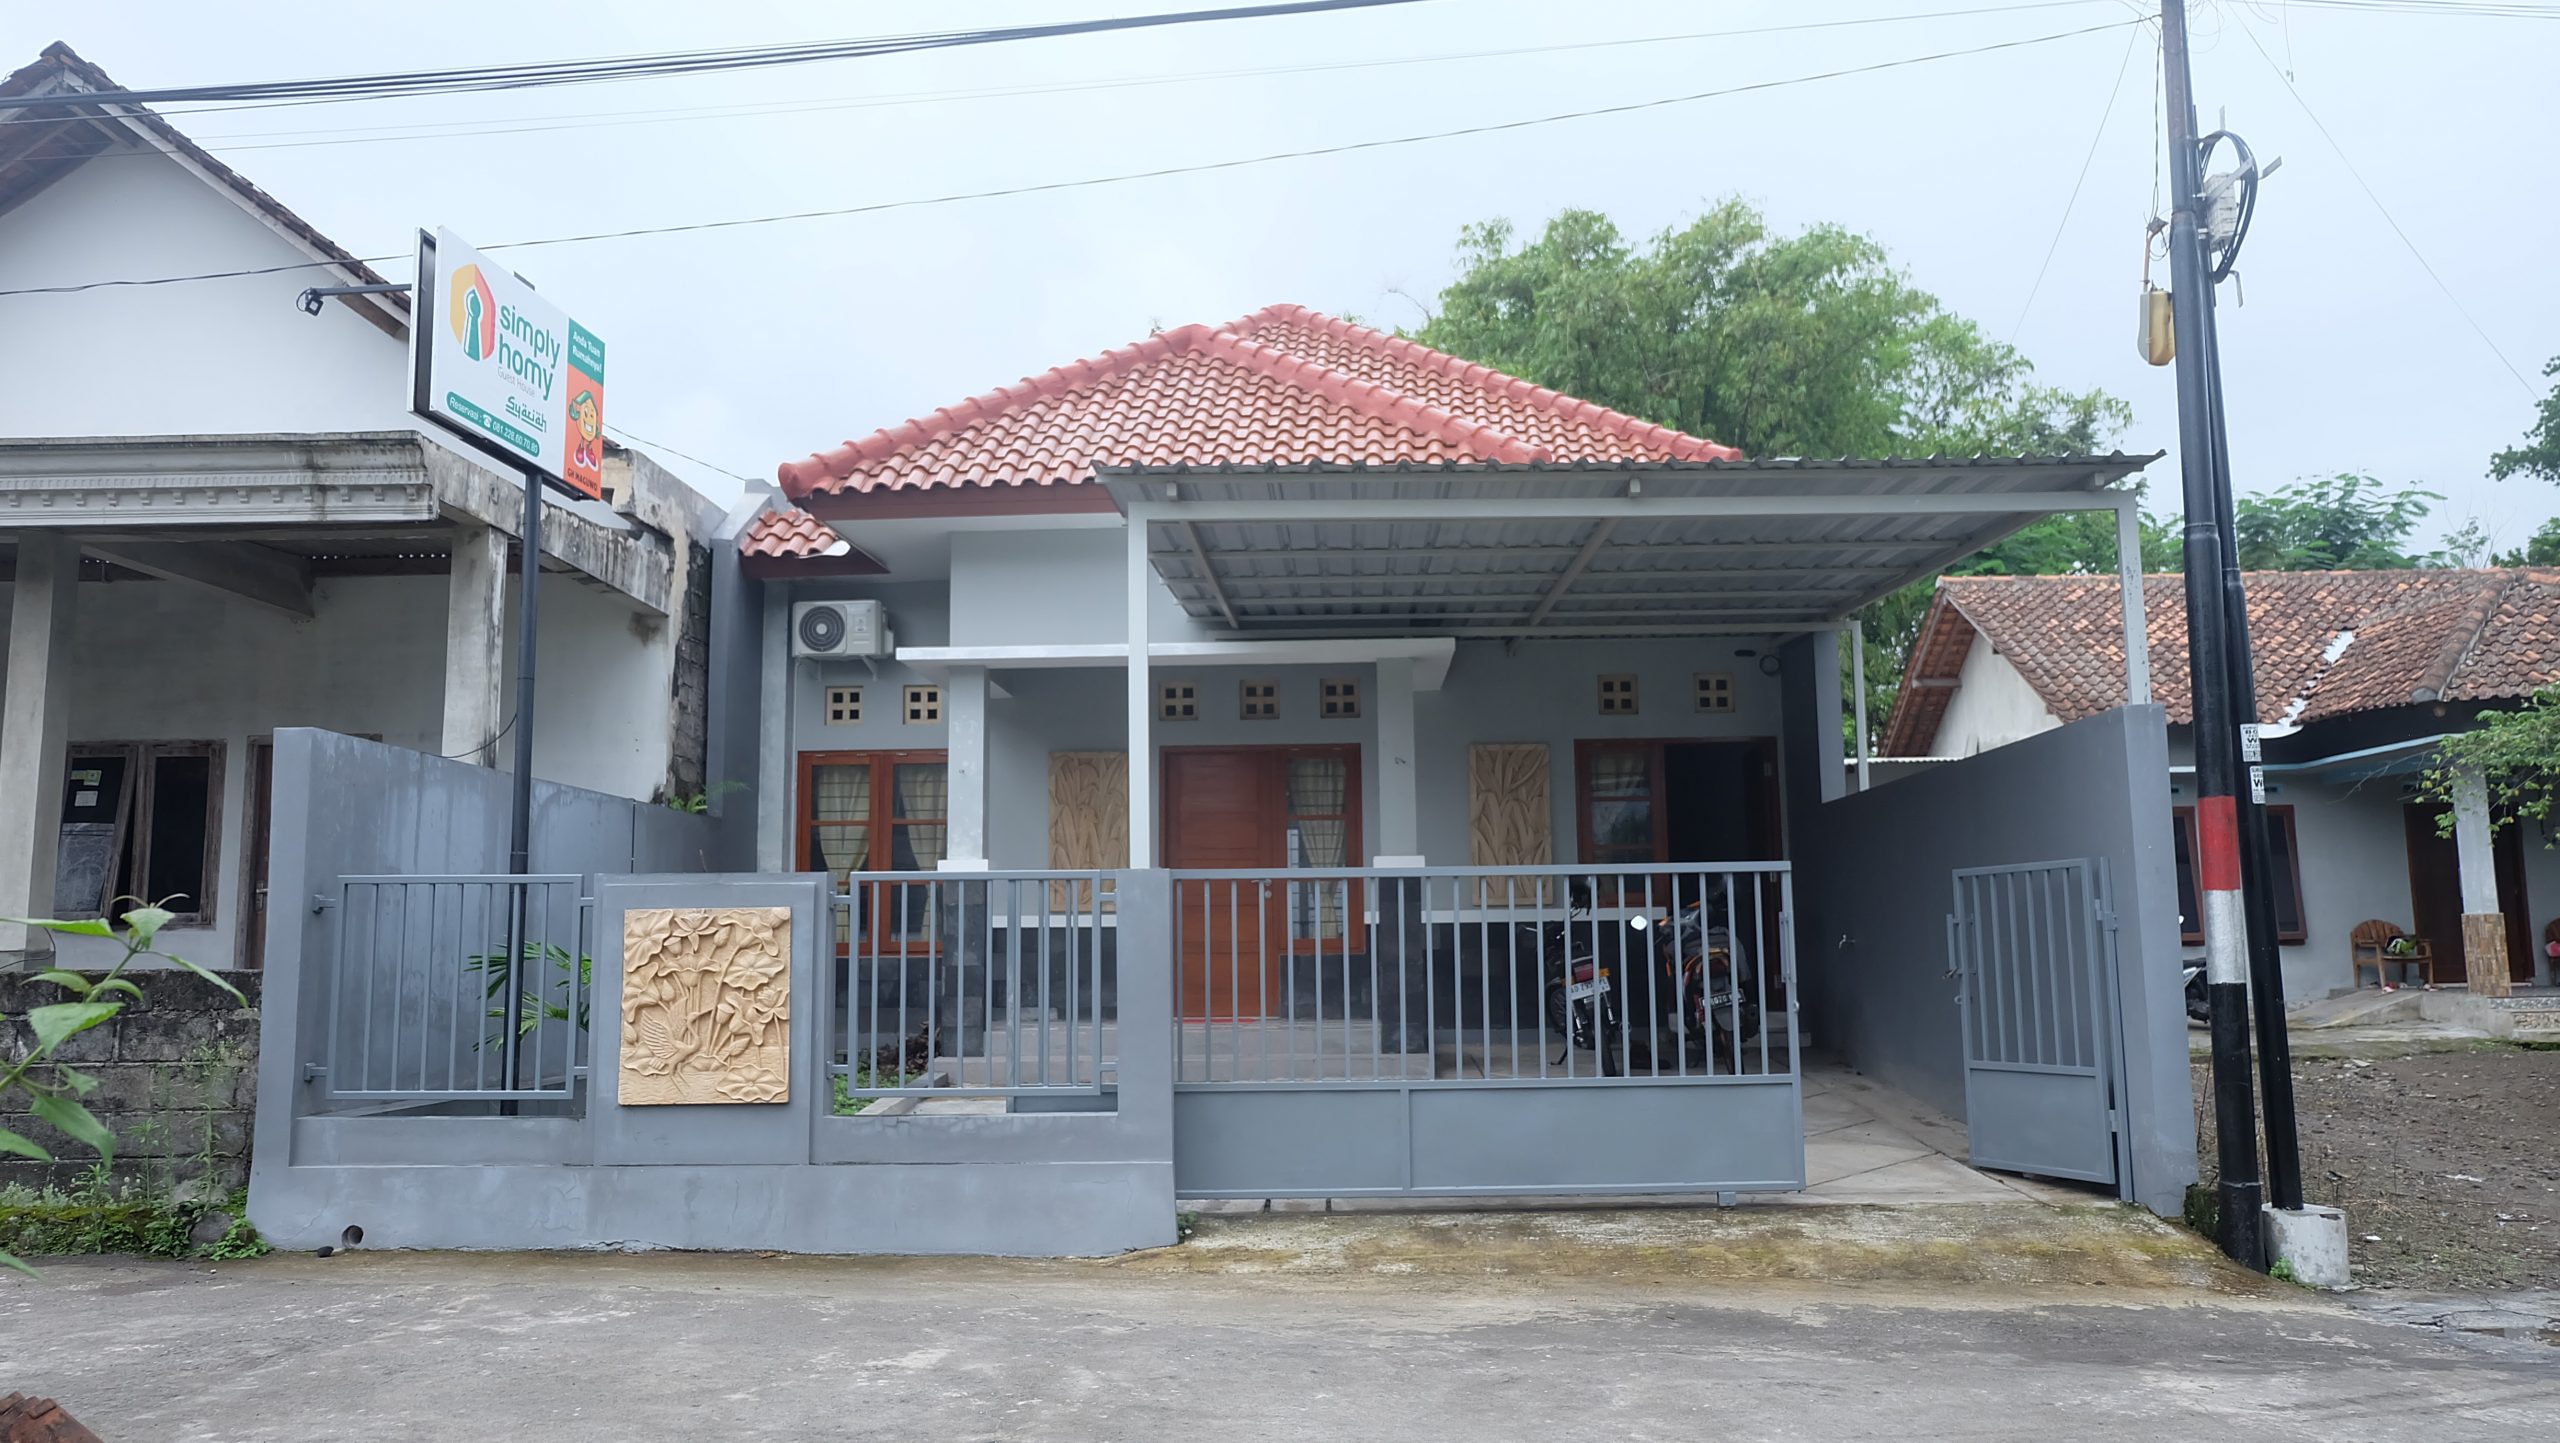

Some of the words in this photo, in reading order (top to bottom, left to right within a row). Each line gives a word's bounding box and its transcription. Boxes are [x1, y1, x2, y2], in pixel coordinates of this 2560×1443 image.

[500, 305, 560, 369] simply
[498, 366, 515, 386] Guest
[517, 379, 535, 398] House
[499, 333, 553, 400] homy
[449, 396, 479, 420] Reservasi
